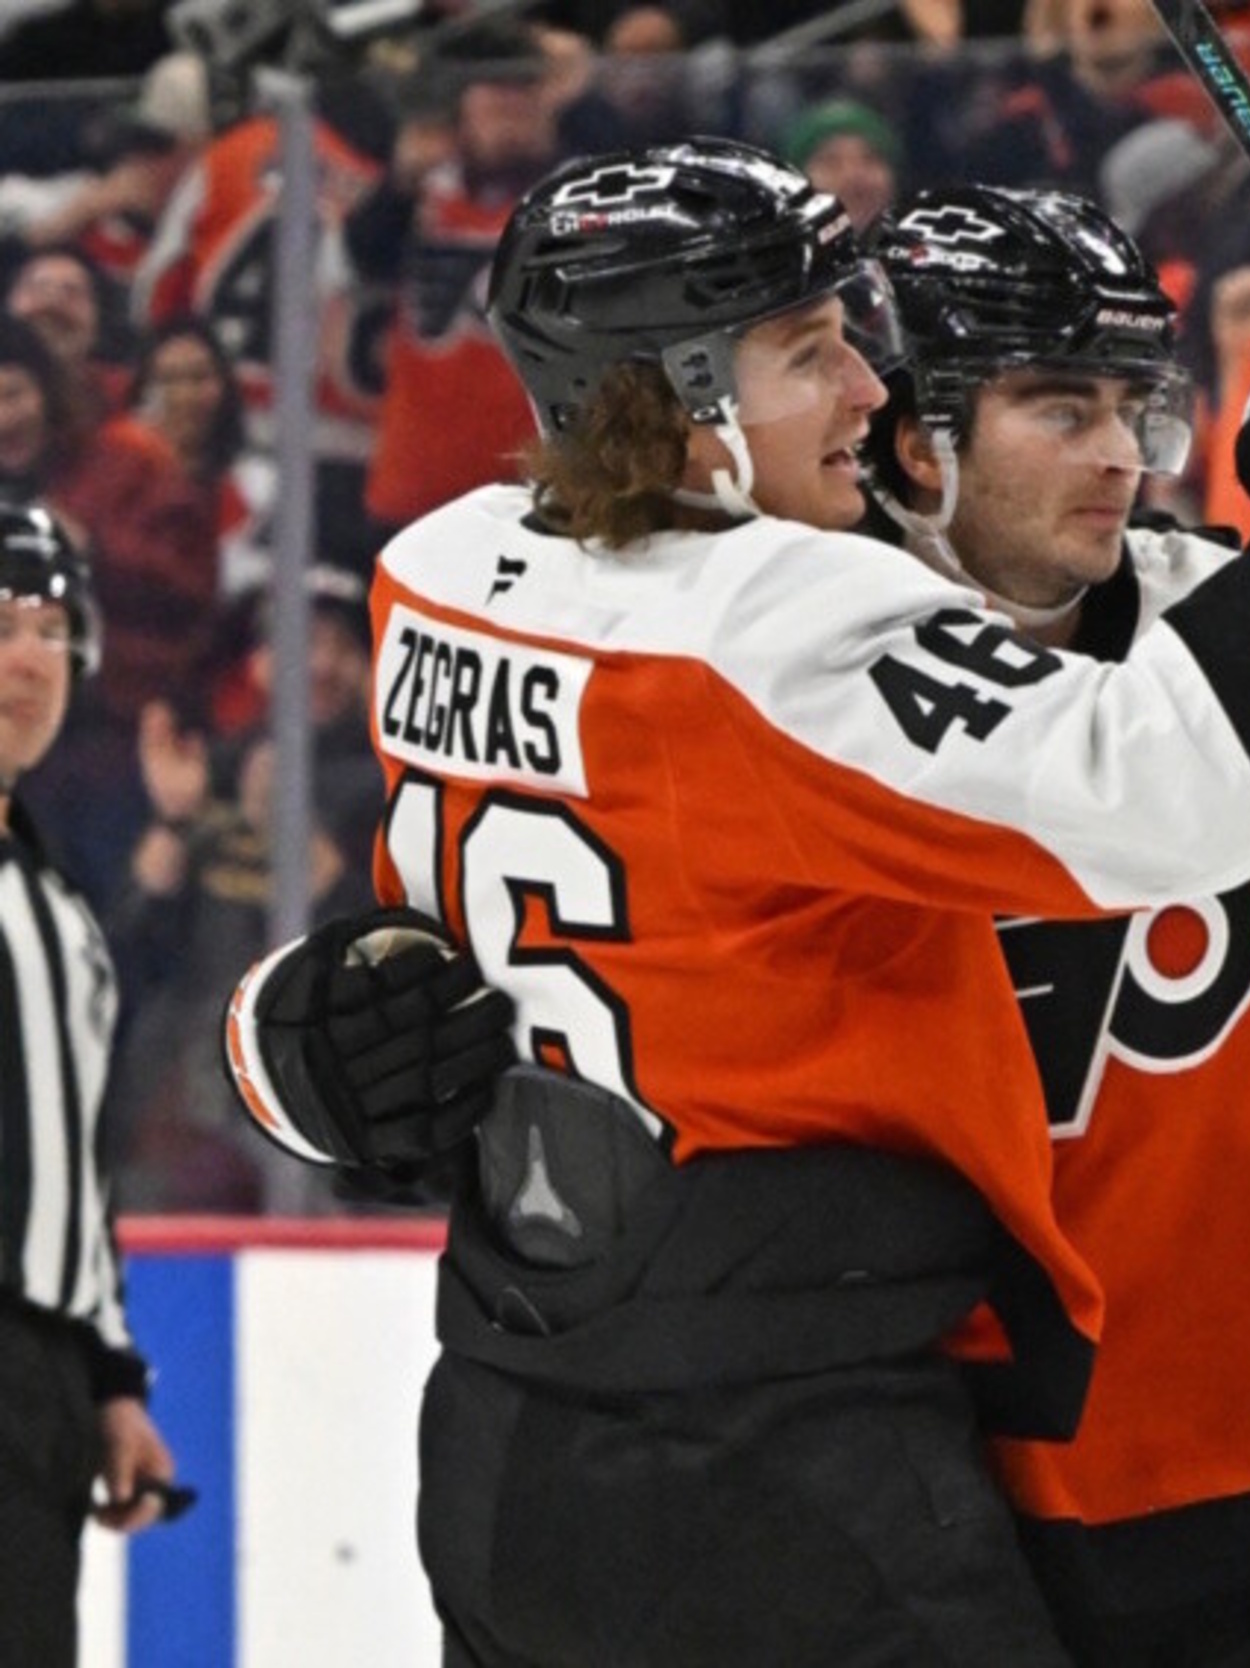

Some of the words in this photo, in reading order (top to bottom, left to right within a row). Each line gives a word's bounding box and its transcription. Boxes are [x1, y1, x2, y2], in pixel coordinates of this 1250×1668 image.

[1097, 310, 1167, 330] BAUER
[383, 627, 561, 777] ZEGRAS
[867, 608, 1064, 755] 46
